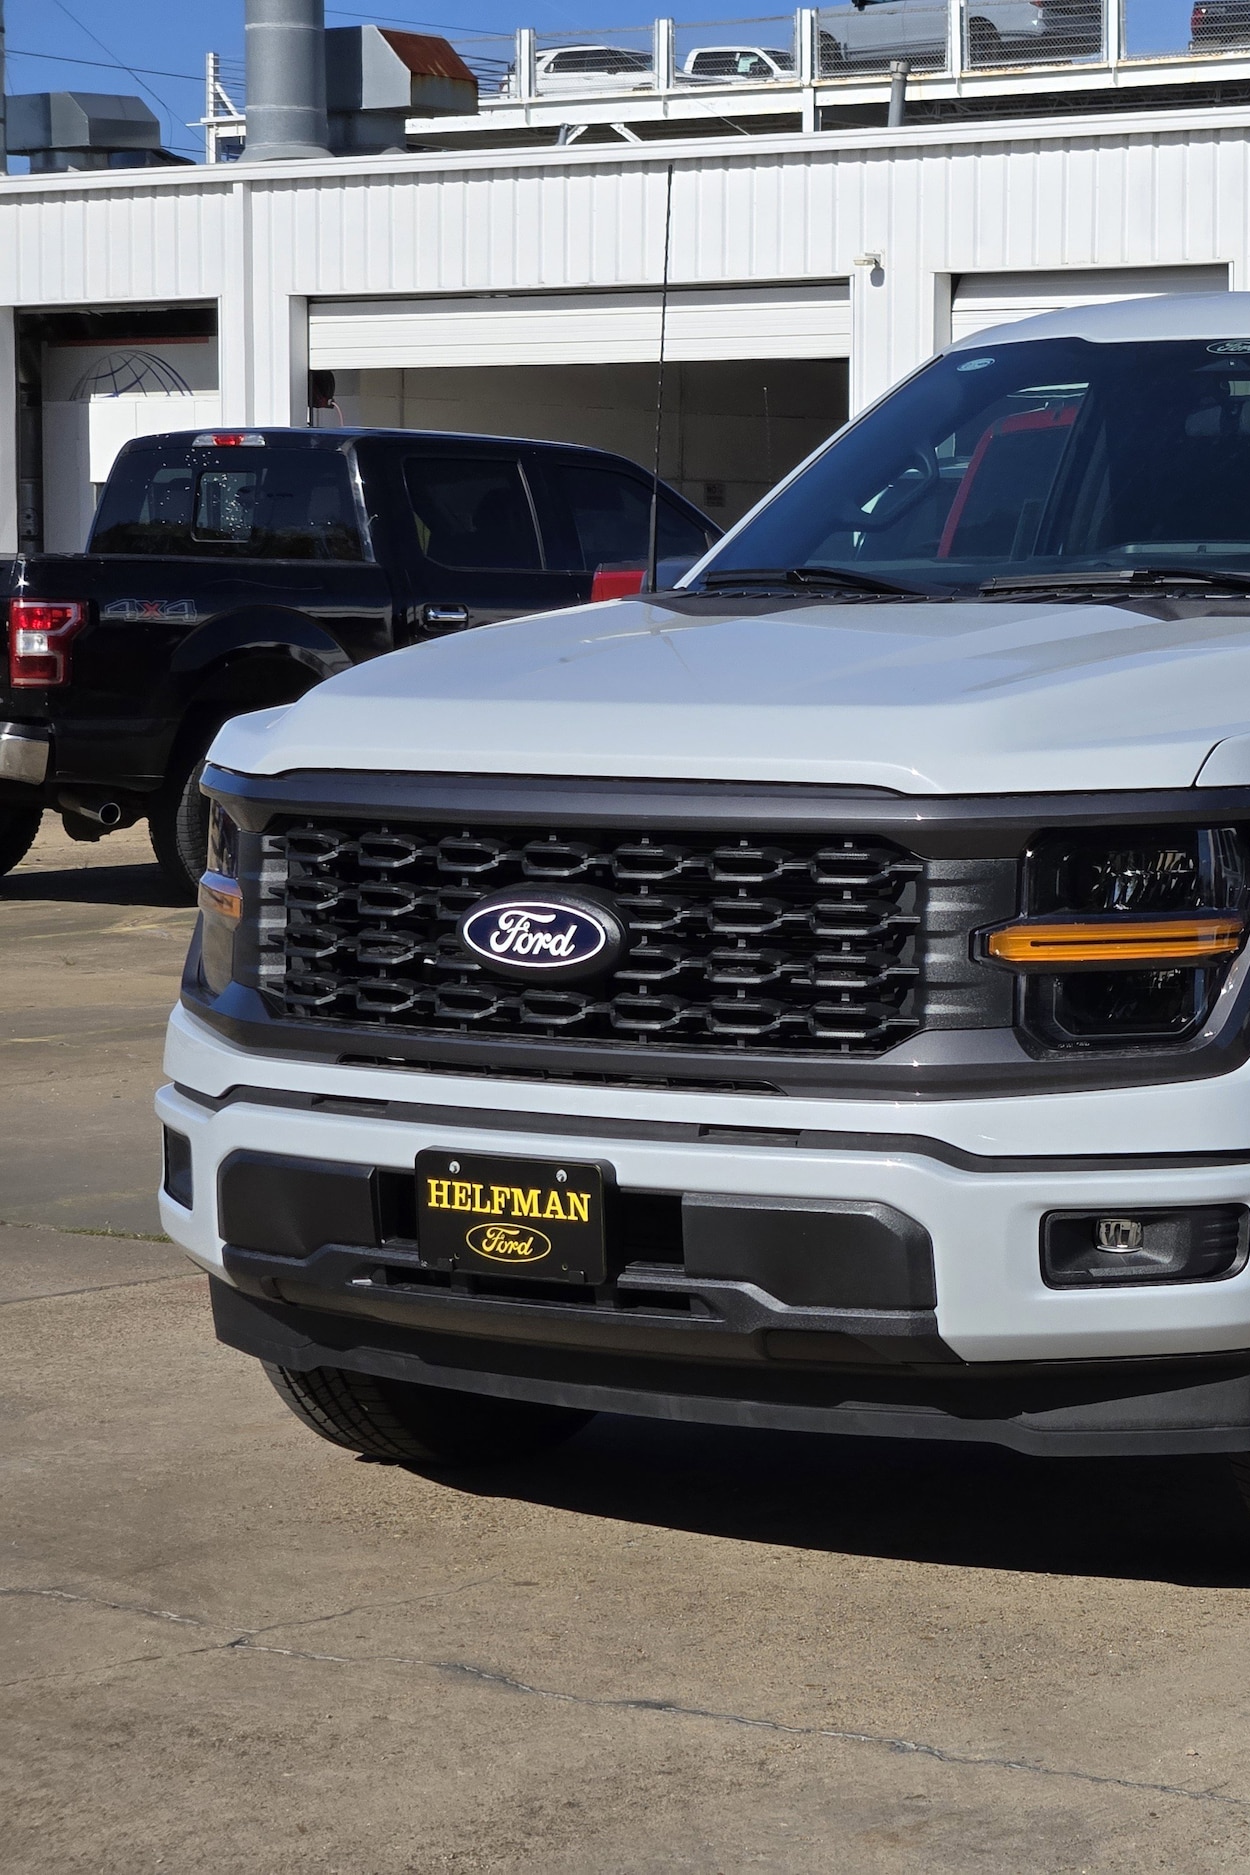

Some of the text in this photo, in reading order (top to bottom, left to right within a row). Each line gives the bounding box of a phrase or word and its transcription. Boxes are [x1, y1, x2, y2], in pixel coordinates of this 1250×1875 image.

[489, 909, 578, 957] Ford
[426, 1178, 592, 1223] HELFMAN
[482, 1226, 535, 1256] Ford
